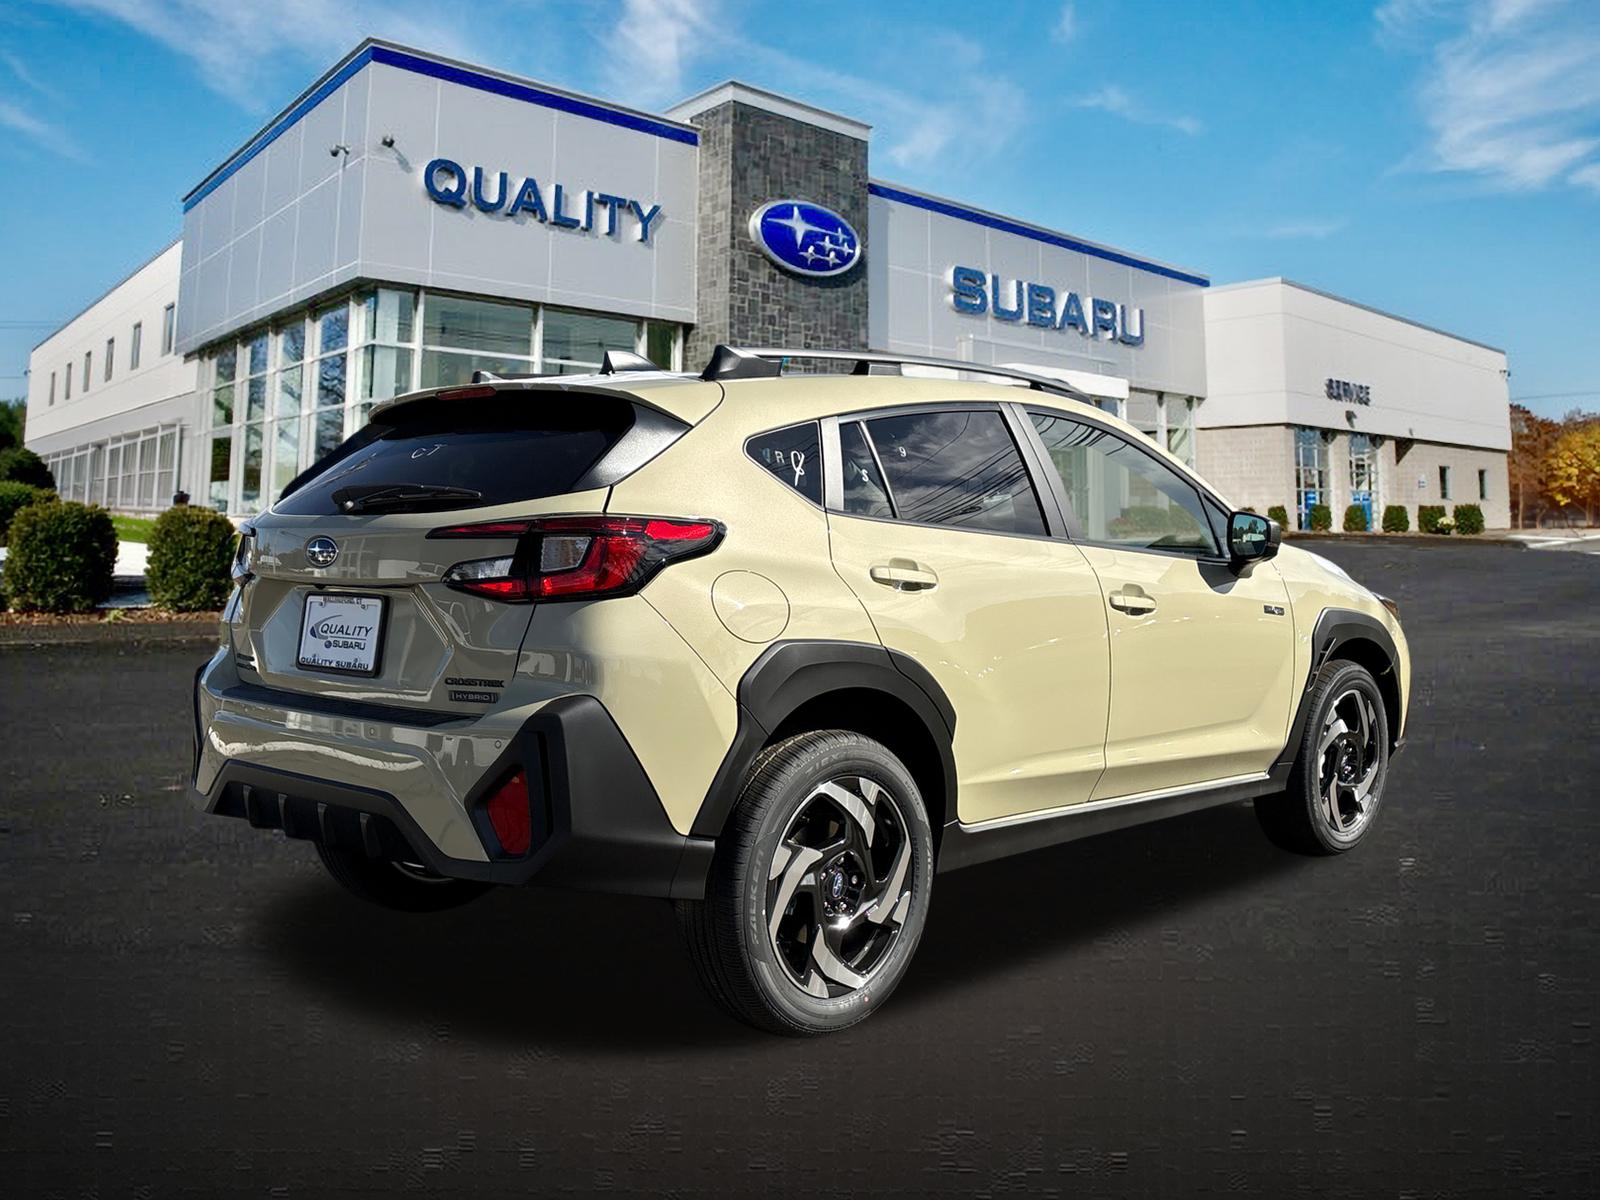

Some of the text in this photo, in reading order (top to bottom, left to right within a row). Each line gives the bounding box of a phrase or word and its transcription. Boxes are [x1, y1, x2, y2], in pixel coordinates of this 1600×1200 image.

[424, 158, 661, 242] QUALITY
[951, 265, 1145, 346] SUBARU
[320, 623, 373, 637] QUALITY
[332, 639, 366, 651] SUBARU
[300, 656, 369, 671] QUALITY SUBARU
[444, 677, 505, 688] CROSSTREK
[455, 692, 490, 701] HYBRID
